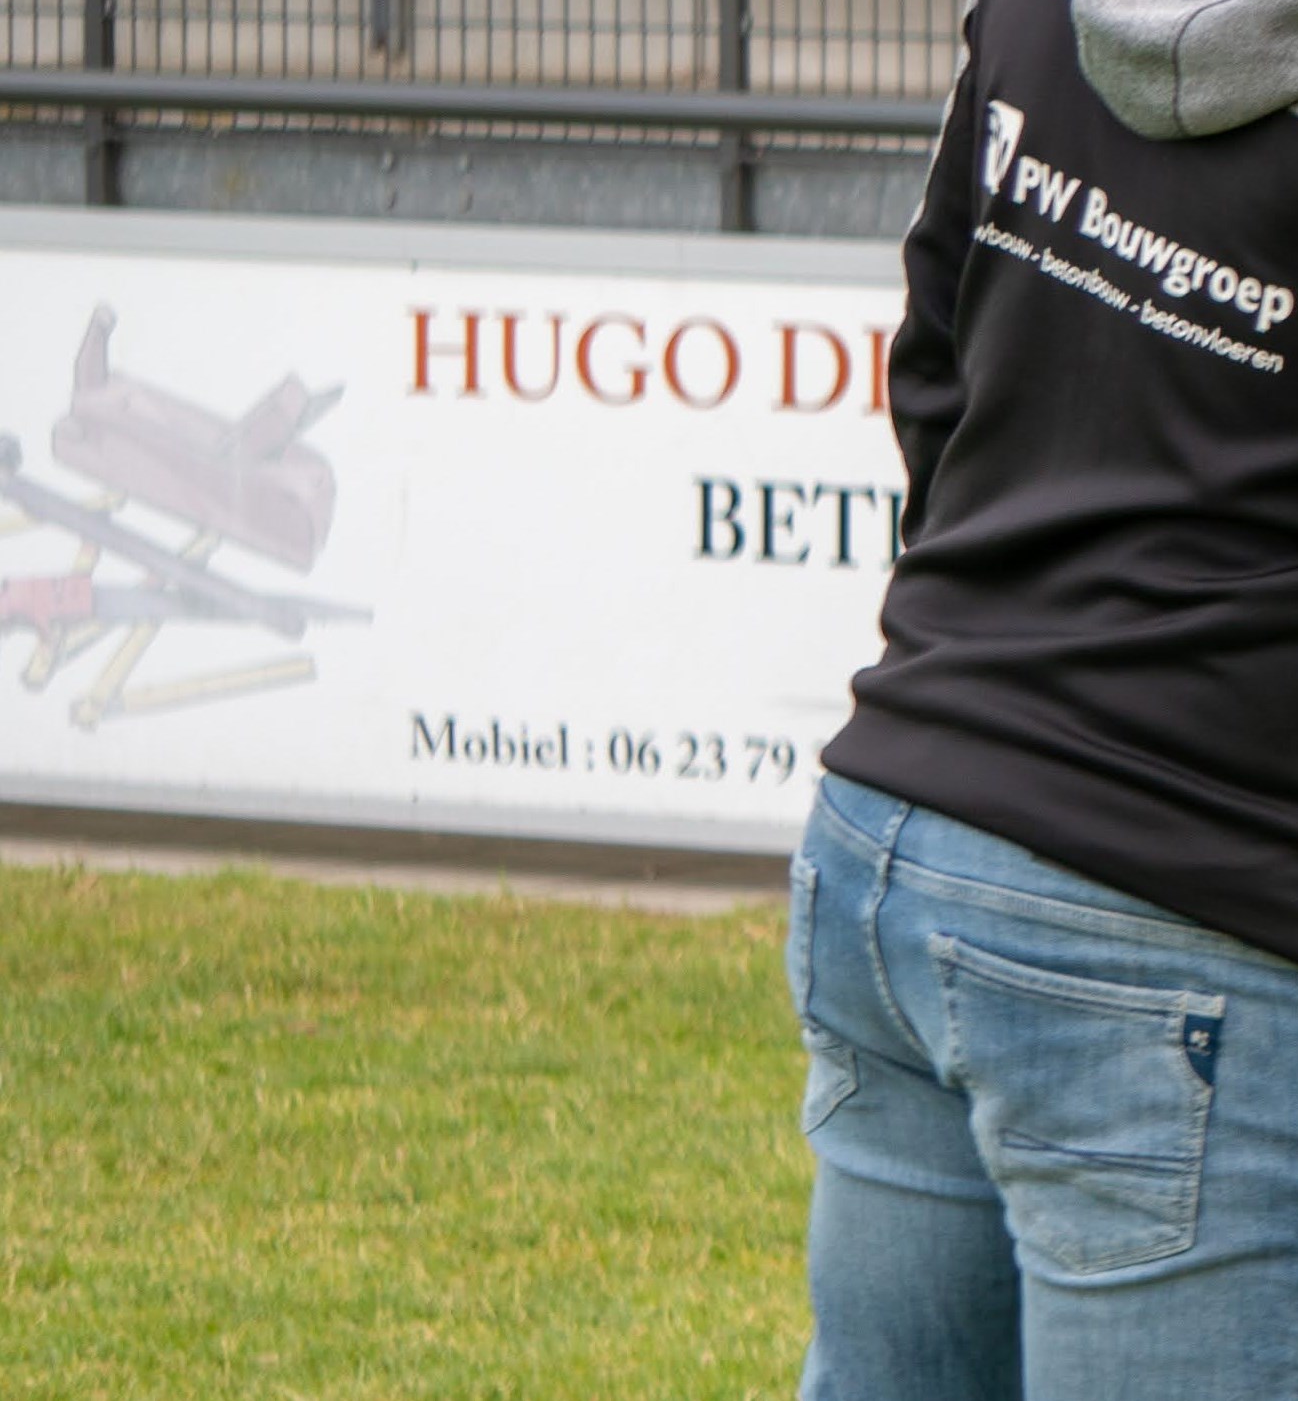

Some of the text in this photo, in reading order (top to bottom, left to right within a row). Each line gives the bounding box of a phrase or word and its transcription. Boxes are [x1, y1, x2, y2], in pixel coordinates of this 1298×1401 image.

[1012, 155, 1295, 333] PW Bouwgroep
[406, 307, 741, 410] HUGO
[1040, 247, 1132, 312] betonbouw
[1139, 298, 1285, 374] betonvloeren
[409, 711, 570, 770] Mobiel
[607, 727, 661, 776] 06
[676, 730, 728, 782] 23
[743, 734, 797, 785] 79
